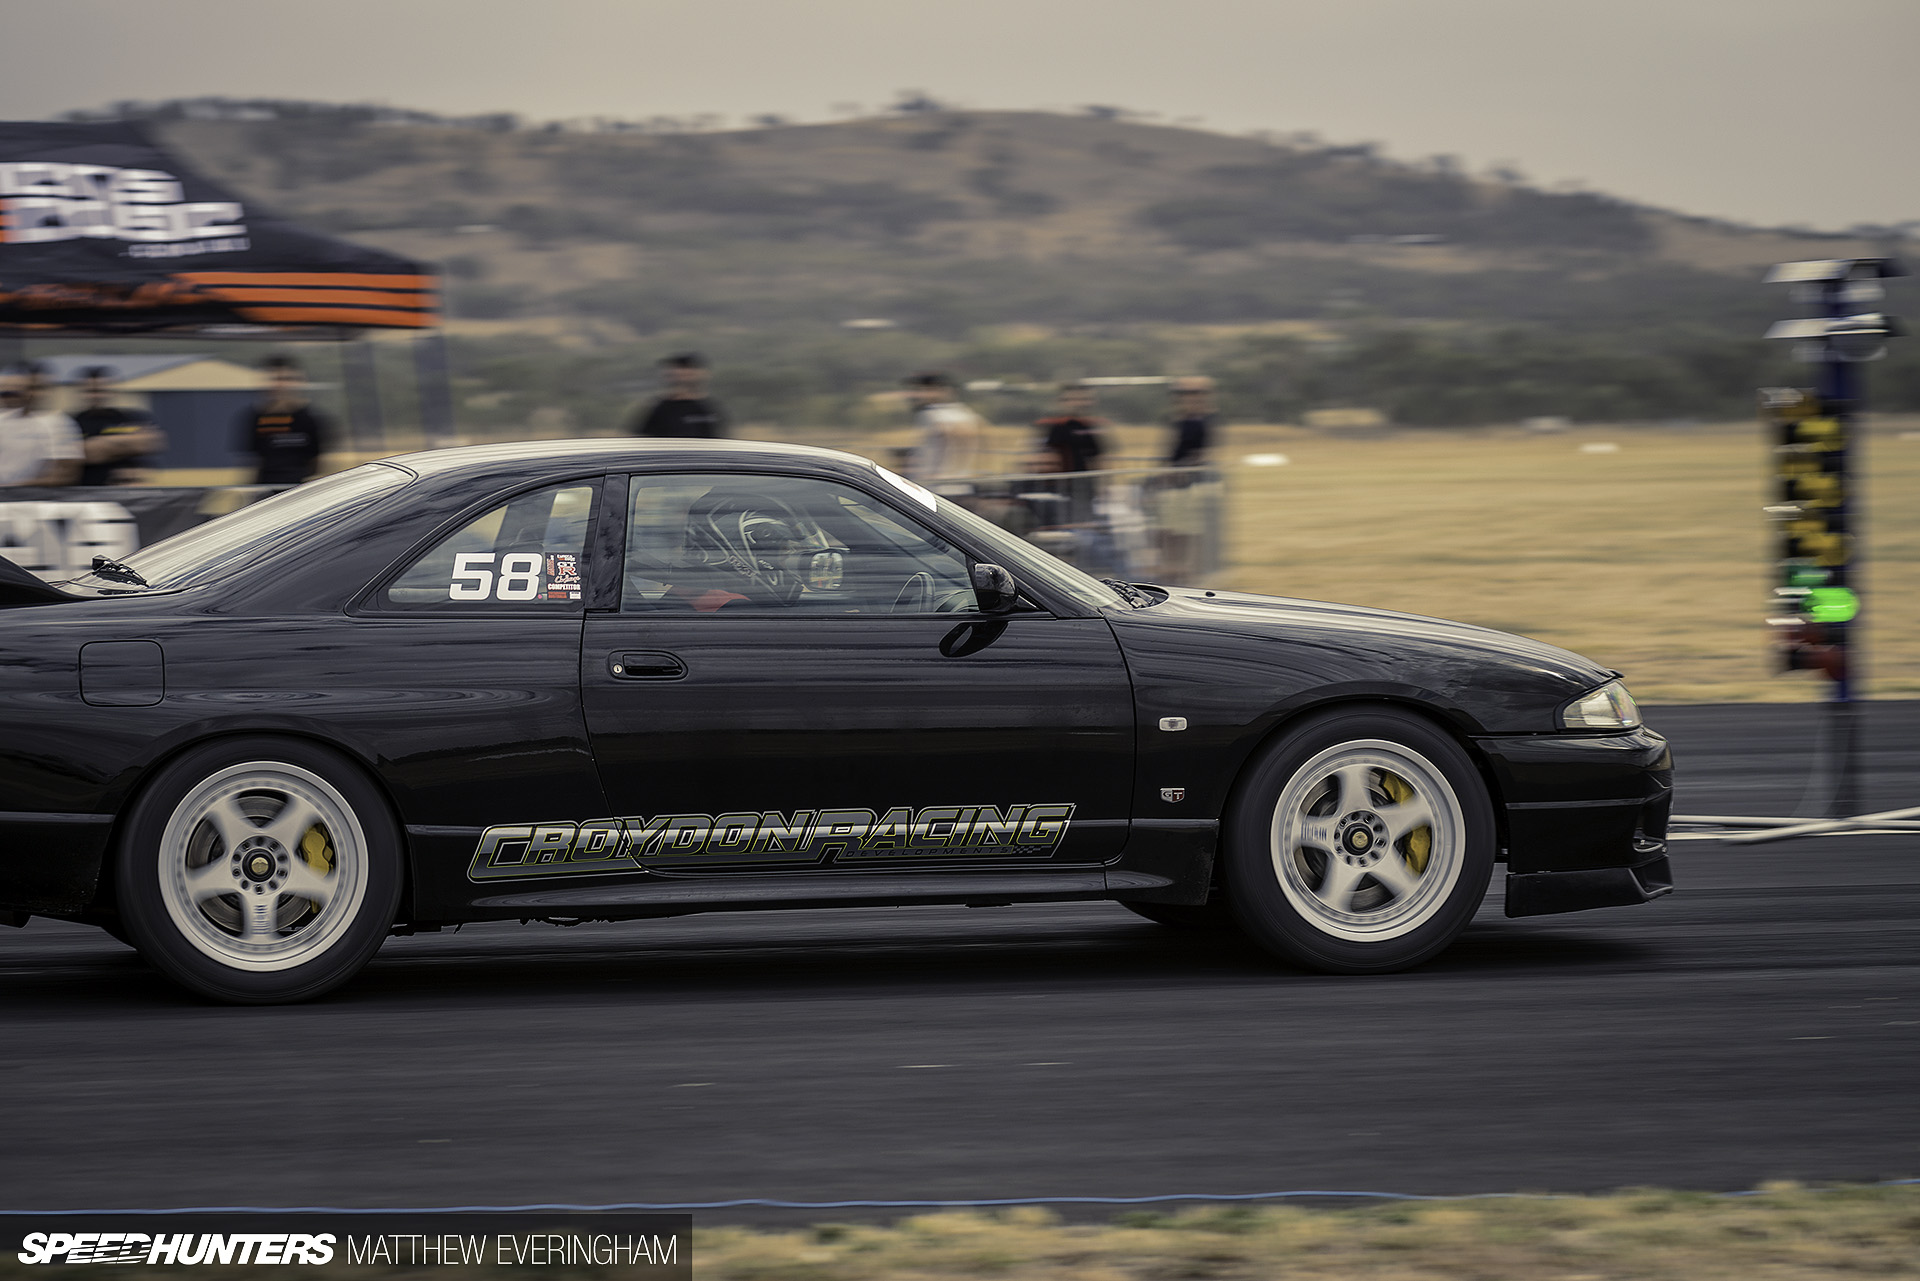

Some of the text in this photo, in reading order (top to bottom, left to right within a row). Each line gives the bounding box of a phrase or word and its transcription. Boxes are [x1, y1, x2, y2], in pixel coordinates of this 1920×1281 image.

[449, 552, 543, 600] 58
[547, 583, 581, 591] COMPETITOR
[1162, 791, 1183, 800] GT
[469, 804, 1076, 881] CROYDON RACING
[845, 848, 1009, 857] DEVELOPMENTS
